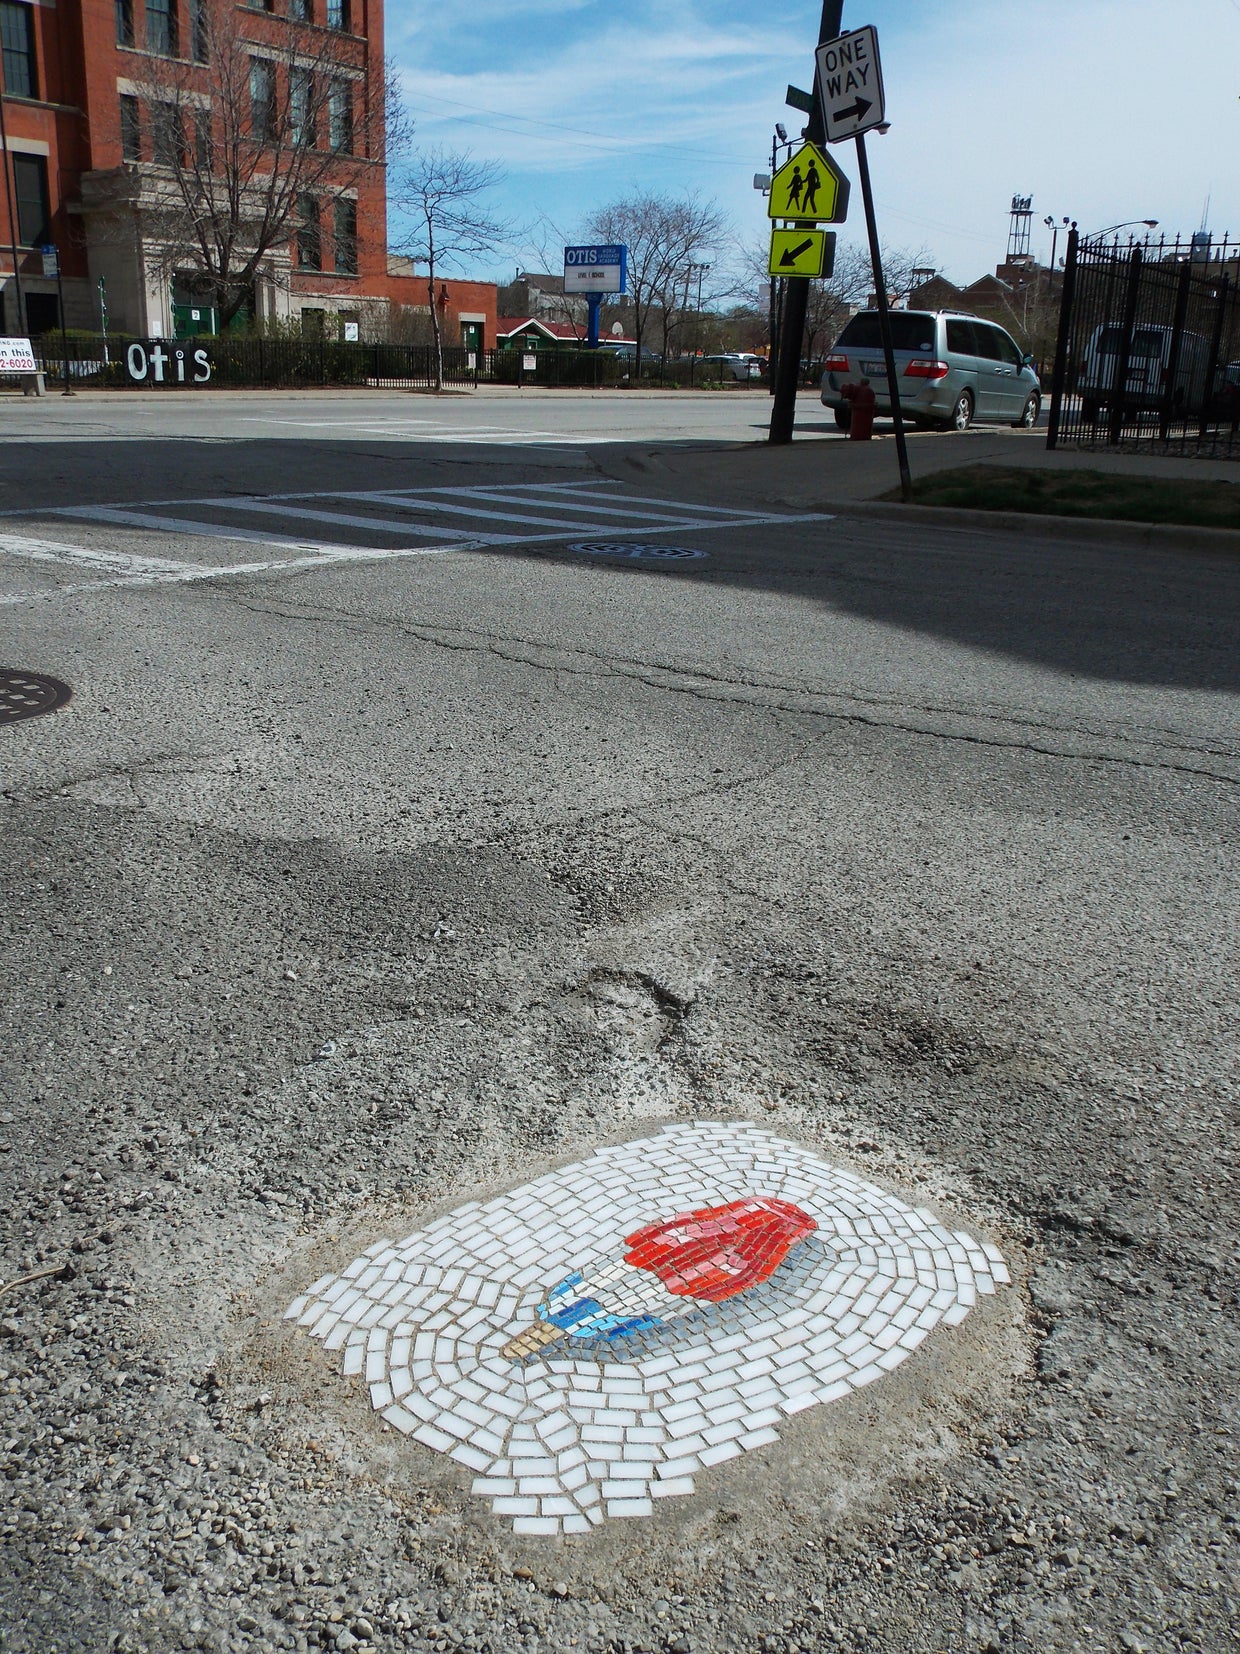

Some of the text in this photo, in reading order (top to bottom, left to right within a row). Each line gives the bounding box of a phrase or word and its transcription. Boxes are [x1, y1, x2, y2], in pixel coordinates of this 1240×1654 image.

[825, 38, 867, 72] ONE
[826, 62, 870, 99] WAY
[567, 250, 597, 264] OTIS
[11, 348, 31, 357] this
[127, 343, 211, 382] Otis
